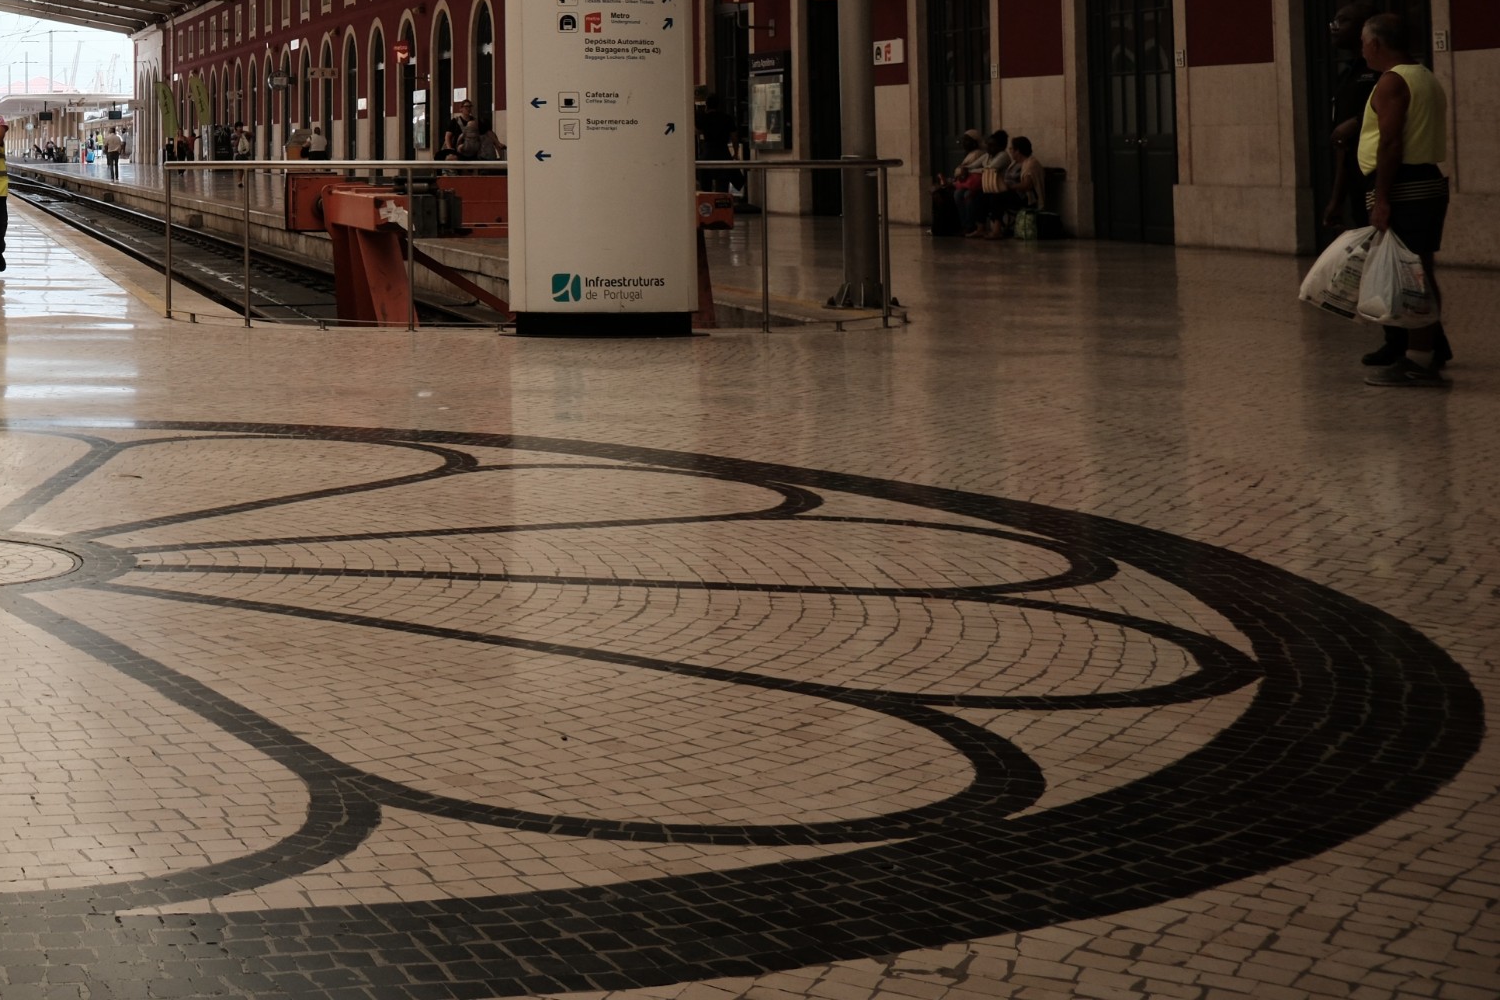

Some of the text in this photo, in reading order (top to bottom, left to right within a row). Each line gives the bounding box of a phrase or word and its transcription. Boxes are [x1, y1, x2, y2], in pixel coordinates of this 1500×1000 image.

[585, 38, 616, 46] Depósito
[1436, 40, 1444, 50] 13
[586, 118, 638, 126] Supermercado
[586, 276, 665, 287] Infraestruturas
[586, 289, 643, 302] de Portugal
